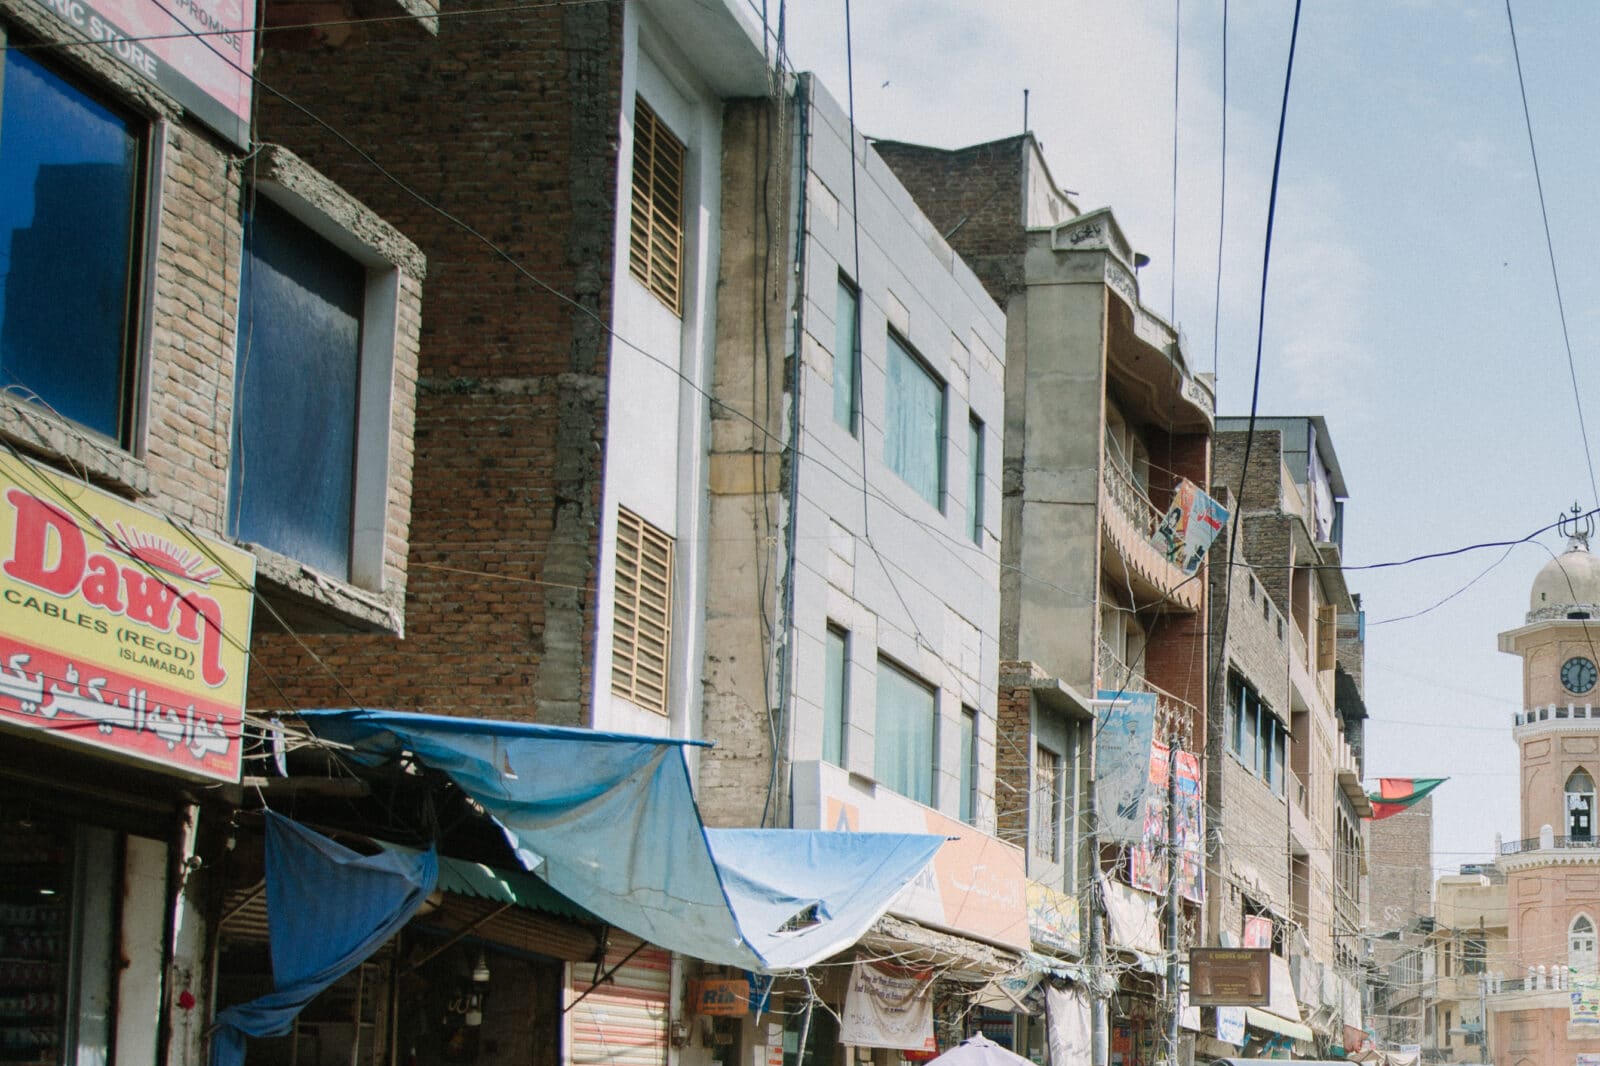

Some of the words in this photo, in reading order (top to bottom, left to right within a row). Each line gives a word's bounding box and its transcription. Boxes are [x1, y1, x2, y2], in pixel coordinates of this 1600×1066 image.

[89, 15, 158, 80] STORE
[3, 488, 226, 688] Dawn
[4, 589, 109, 636] CABLES
[116, 626, 196, 667] (REGD)
[119, 647, 196, 681] ISLAMABAD
